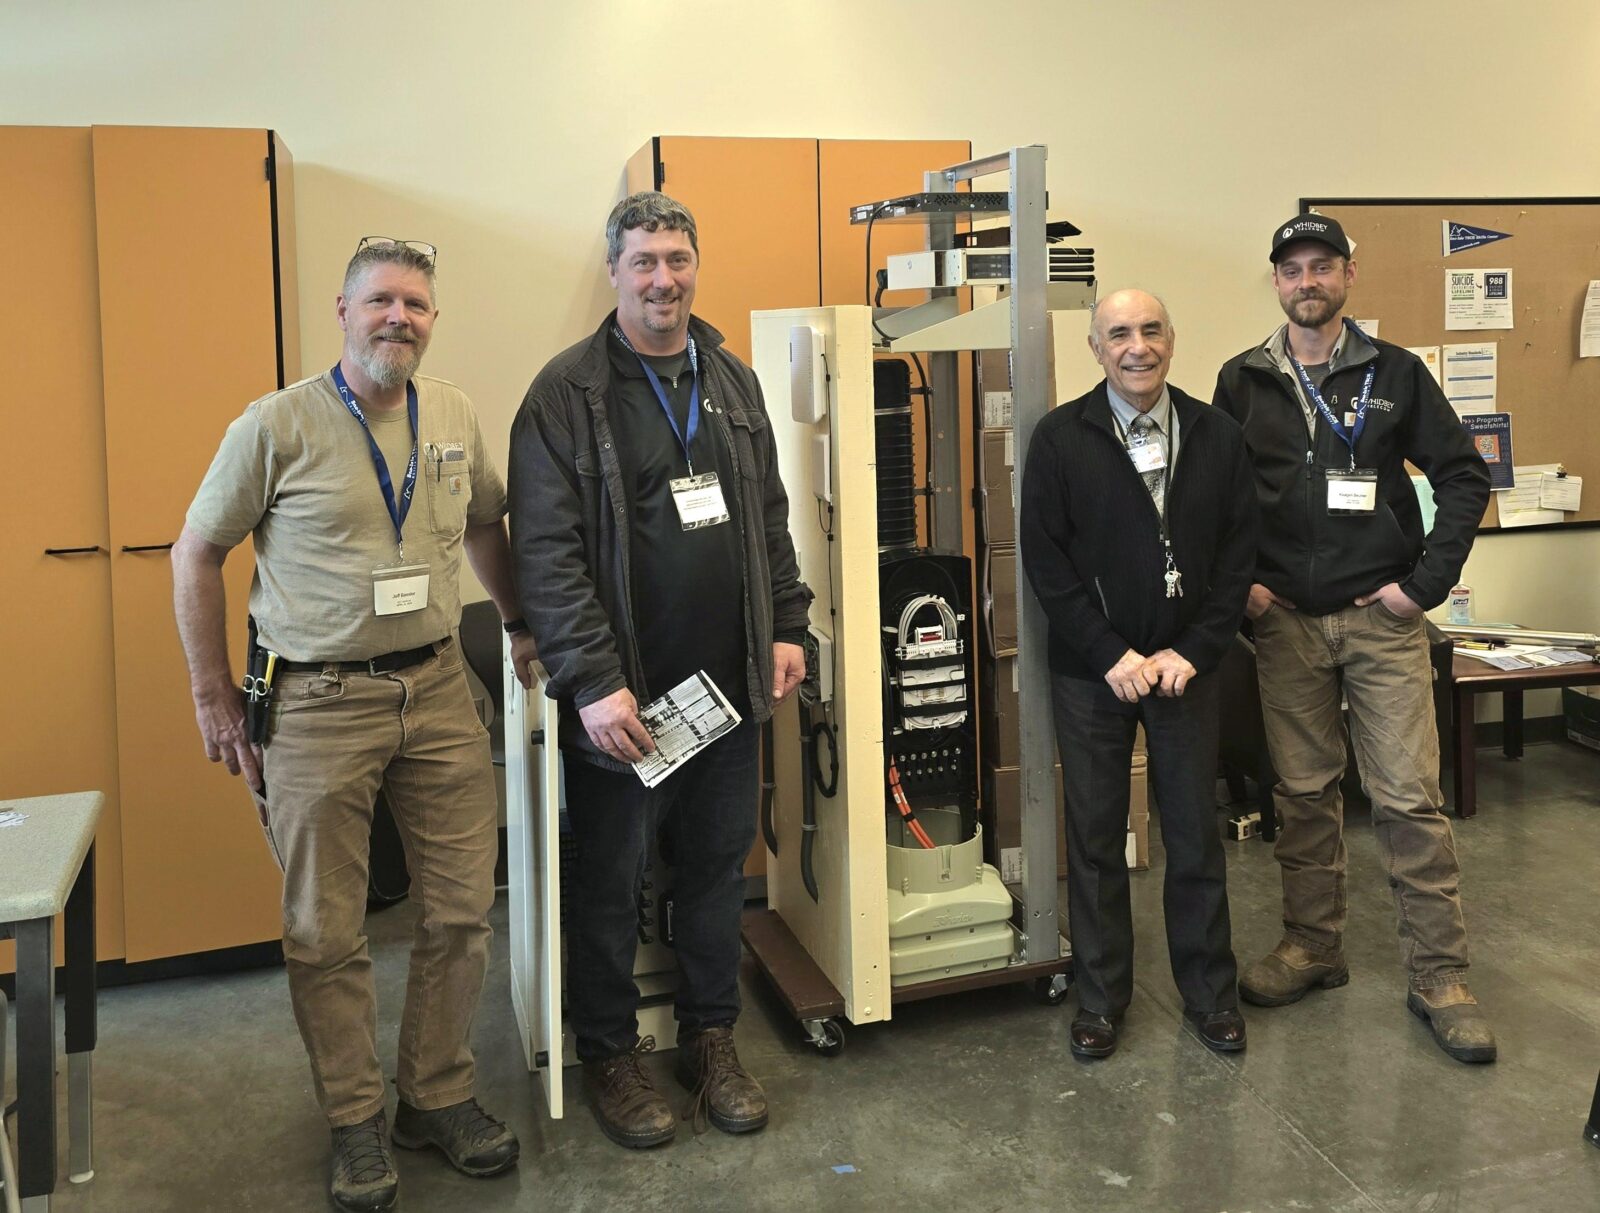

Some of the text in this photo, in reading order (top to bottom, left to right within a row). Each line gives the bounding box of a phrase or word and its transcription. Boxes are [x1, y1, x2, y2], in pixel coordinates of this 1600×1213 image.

[1294, 221, 1328, 230] WHIDBEY
[1451, 276, 1474, 286] SUICIDE
[1489, 277, 1504, 285] 988
[1470, 421, 1509, 430] Sweatshirts!
